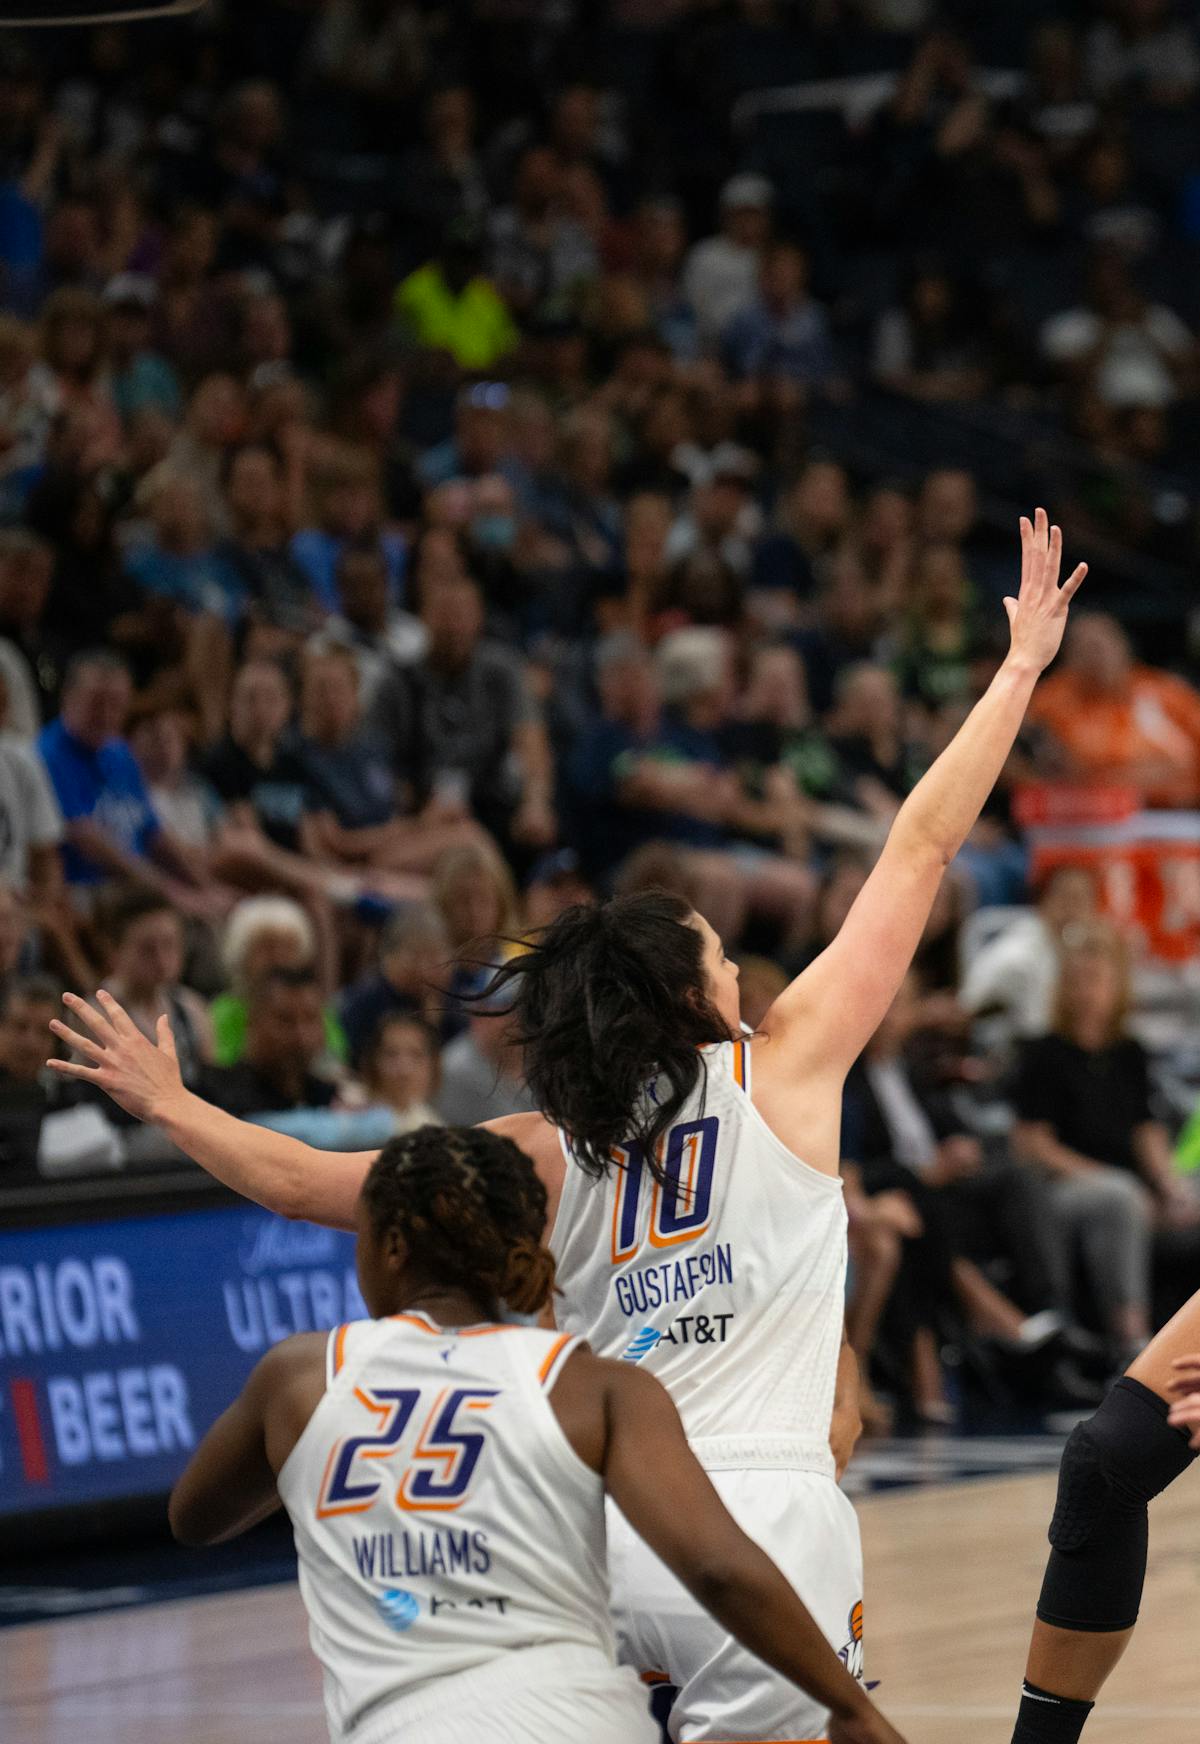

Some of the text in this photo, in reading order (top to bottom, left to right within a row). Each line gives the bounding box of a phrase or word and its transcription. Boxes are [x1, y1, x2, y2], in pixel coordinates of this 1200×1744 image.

[610, 1116, 719, 1265] 10
[0, 1255, 141, 1355] RIOR
[656, 1314, 734, 1347] AT&T
[47, 1364, 196, 1466] BEER
[316, 1386, 503, 1521] 25
[353, 1530, 492, 1579] WILLIAMS
